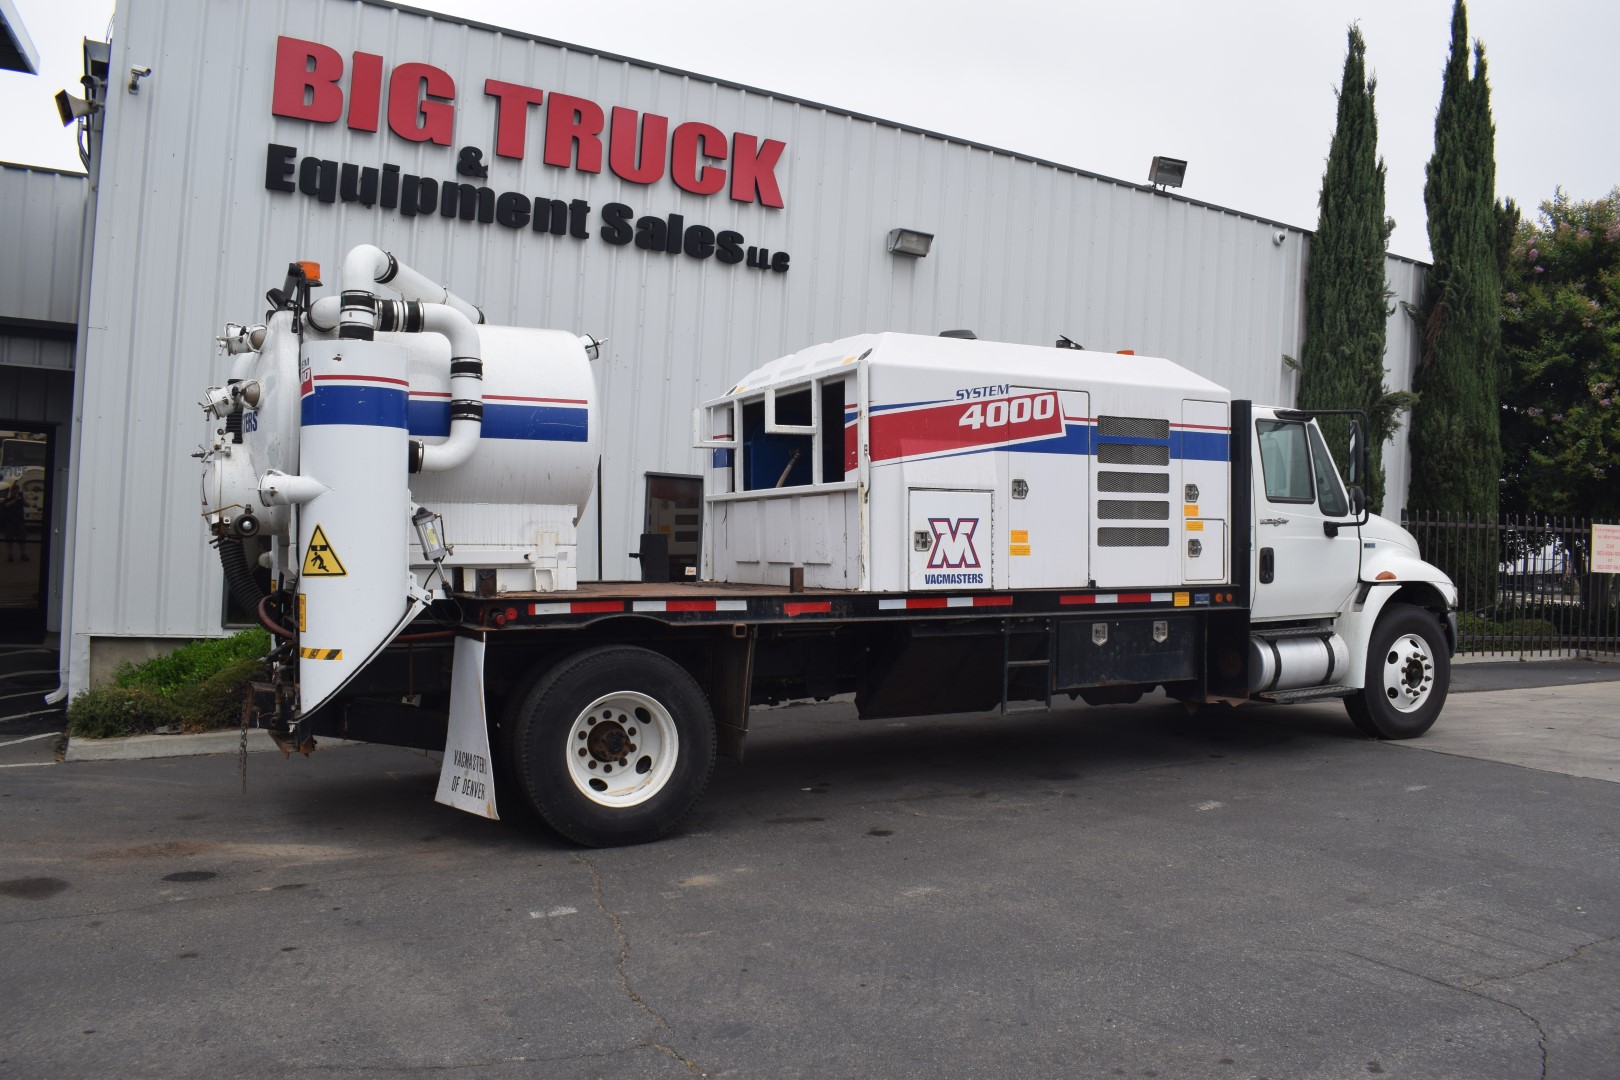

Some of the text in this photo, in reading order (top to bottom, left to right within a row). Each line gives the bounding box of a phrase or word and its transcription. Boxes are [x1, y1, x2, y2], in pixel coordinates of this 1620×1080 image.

[272, 35, 787, 210] BIG TRUCK
[457, 145, 488, 179] &
[265, 143, 591, 240] Equipment
[600, 201, 745, 265] Sales
[956, 384, 1009, 401] SYSTEM
[959, 394, 1055, 430] 4000
[925, 573, 984, 585] VACMASTERS
[451, 775, 485, 801] OF DENVER
